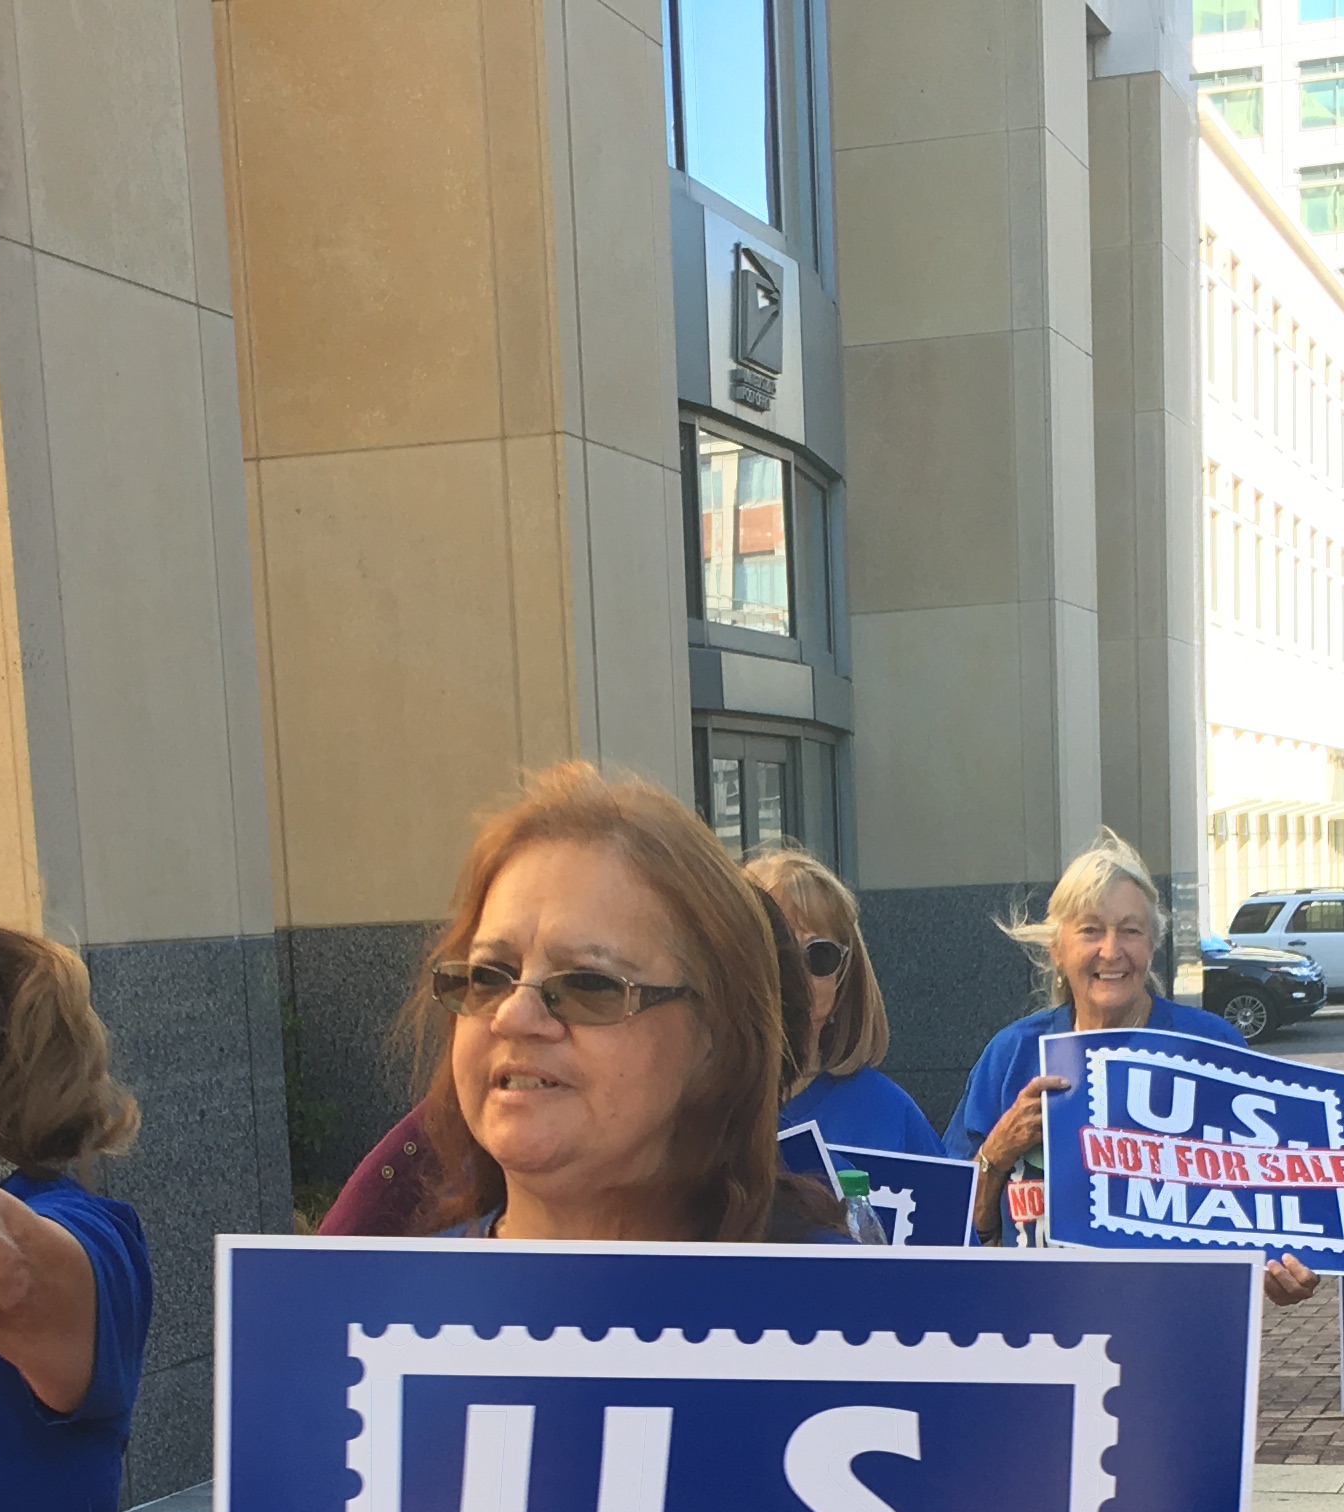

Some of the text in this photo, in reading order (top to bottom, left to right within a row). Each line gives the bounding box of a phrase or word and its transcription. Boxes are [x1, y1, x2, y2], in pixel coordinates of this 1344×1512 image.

[1126, 1067, 1309, 1150] U.S.
[1089, 1134, 1164, 1175] NOT
[1175, 1145, 1250, 1182] FOR
[1125, 1177, 1324, 1234] MAIL
